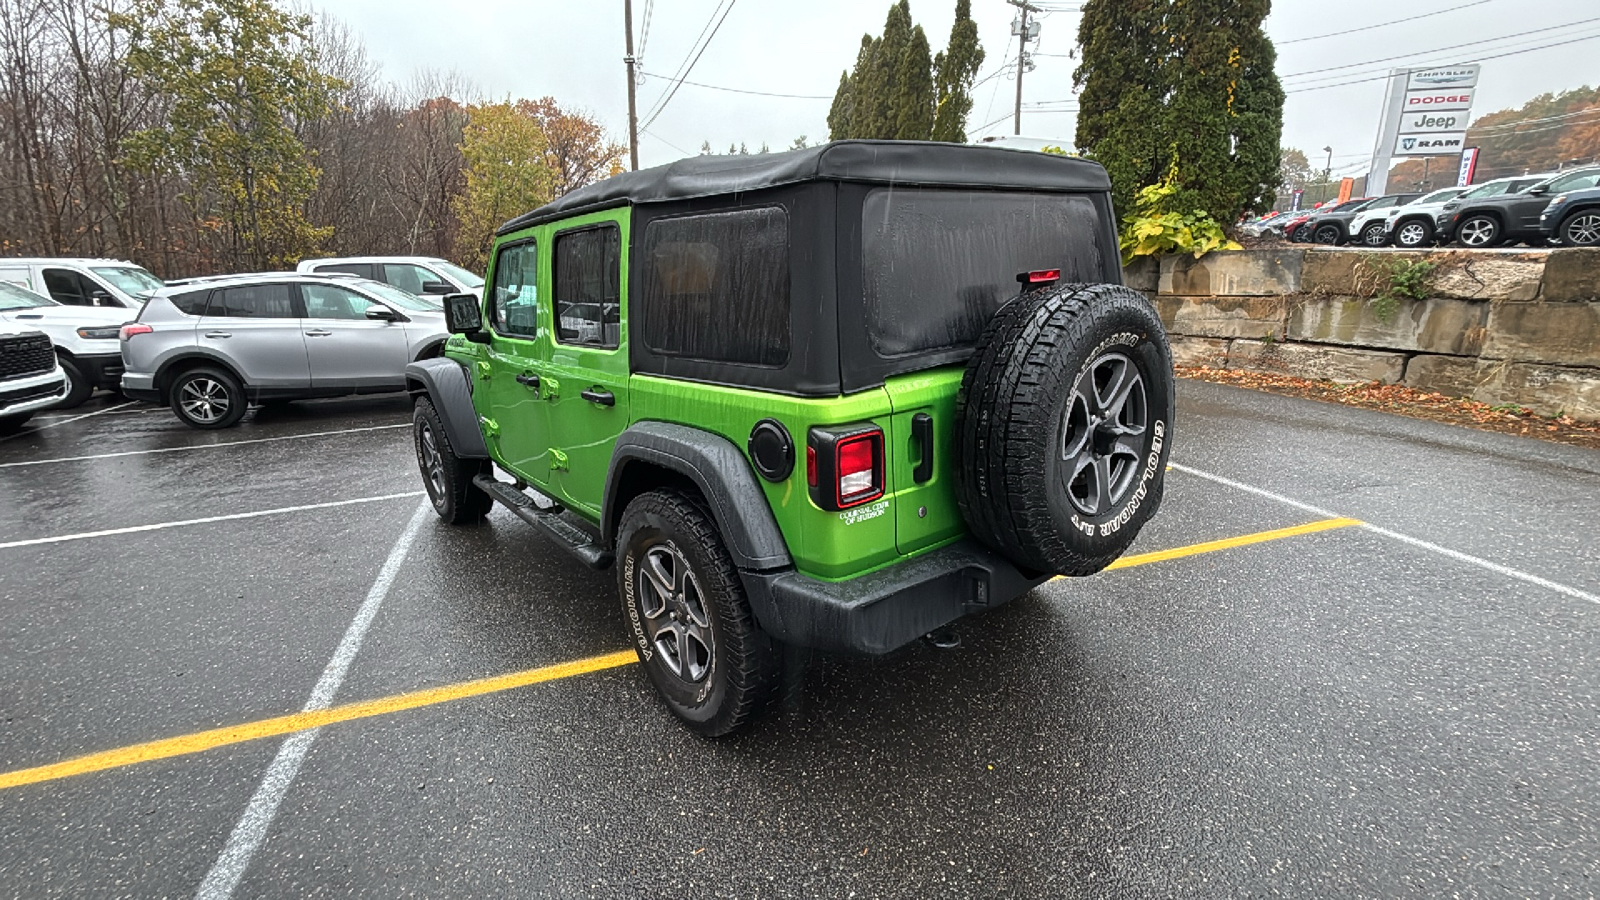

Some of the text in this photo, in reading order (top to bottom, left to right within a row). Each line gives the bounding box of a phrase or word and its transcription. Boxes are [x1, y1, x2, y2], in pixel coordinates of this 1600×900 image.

[1409, 95, 1470, 104] DODGE
[1414, 115, 1456, 128] Jeep
[1071, 419, 1165, 537] GEOLANDAR A/T
[845, 508, 885, 525] OF HUDSON
[624, 554, 653, 662] YOKOHAMA
